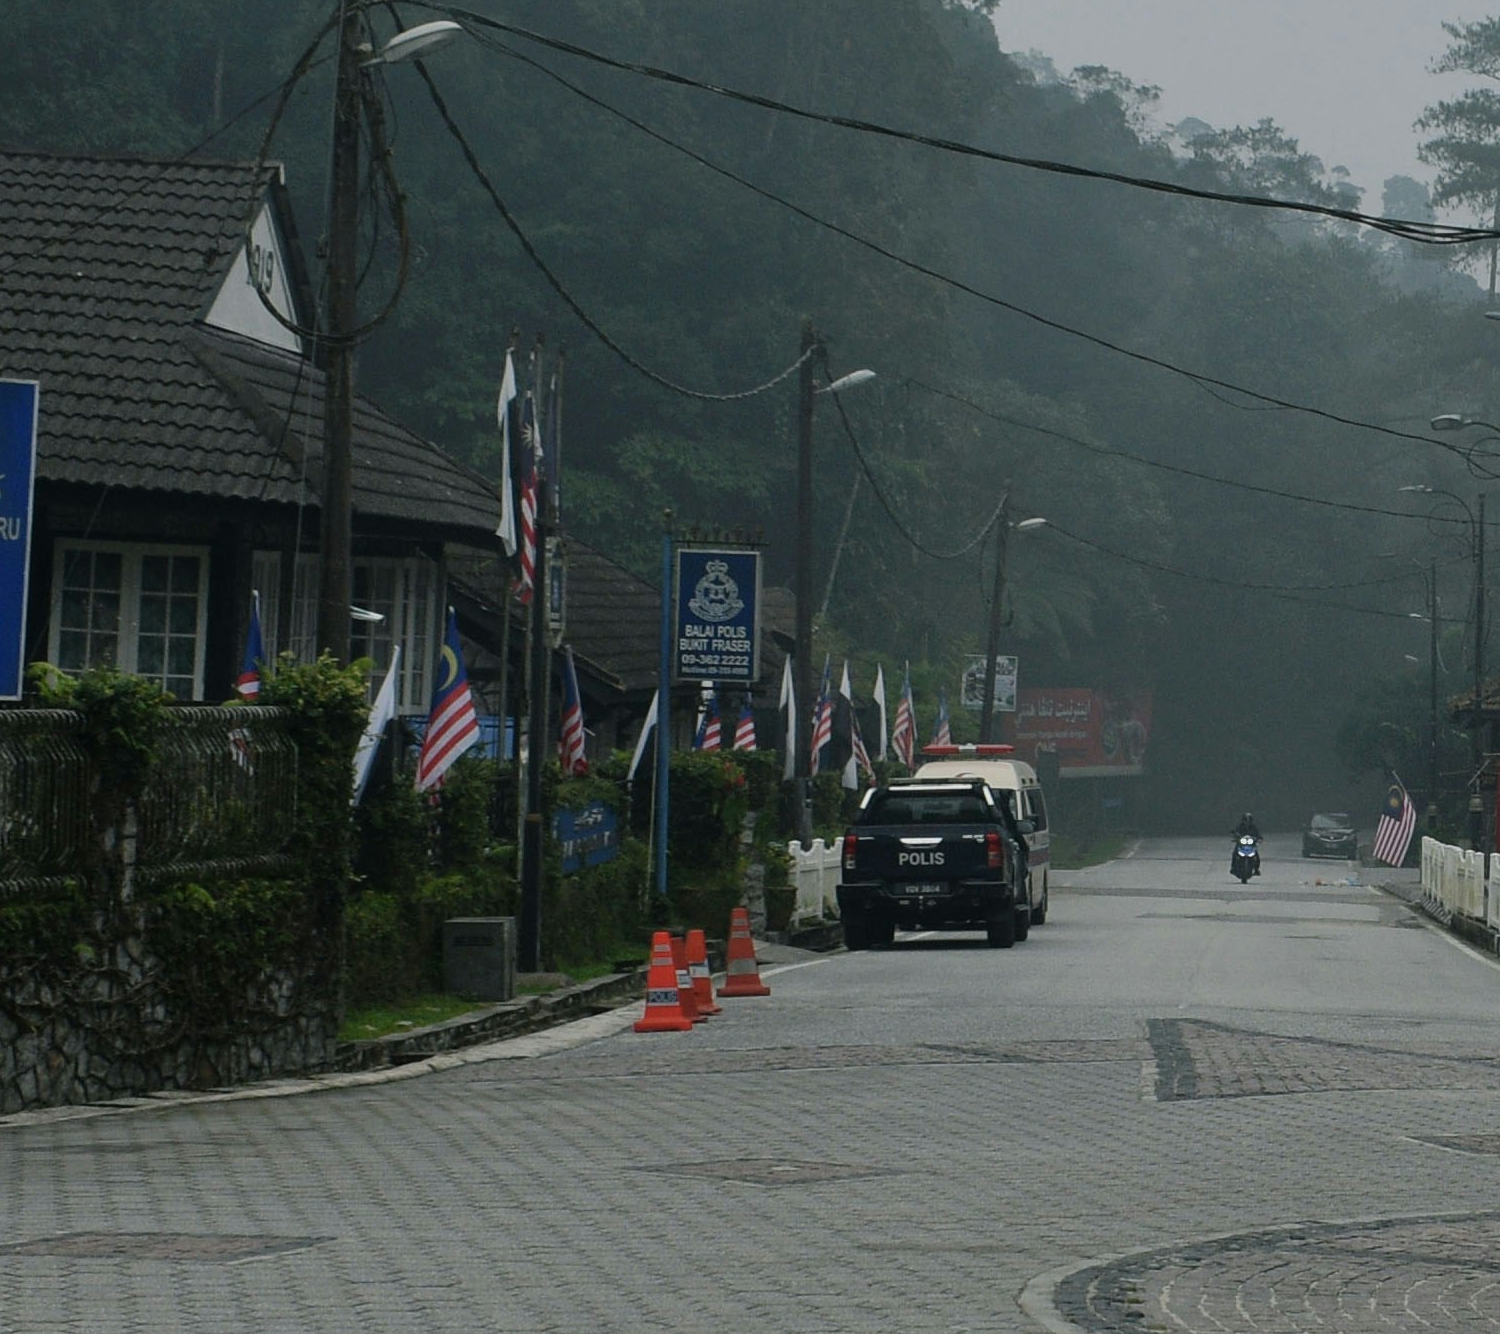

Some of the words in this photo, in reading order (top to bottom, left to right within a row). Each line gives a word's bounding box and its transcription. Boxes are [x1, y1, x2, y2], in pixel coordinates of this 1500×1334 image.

[685, 624, 715, 637] BALAI
[717, 625, 747, 638] POLIS
[680, 638, 709, 651] BUKIT
[712, 639, 751, 652] FRASER
[721, 655, 749, 666] 2222
[899, 852, 945, 866] POLIS
